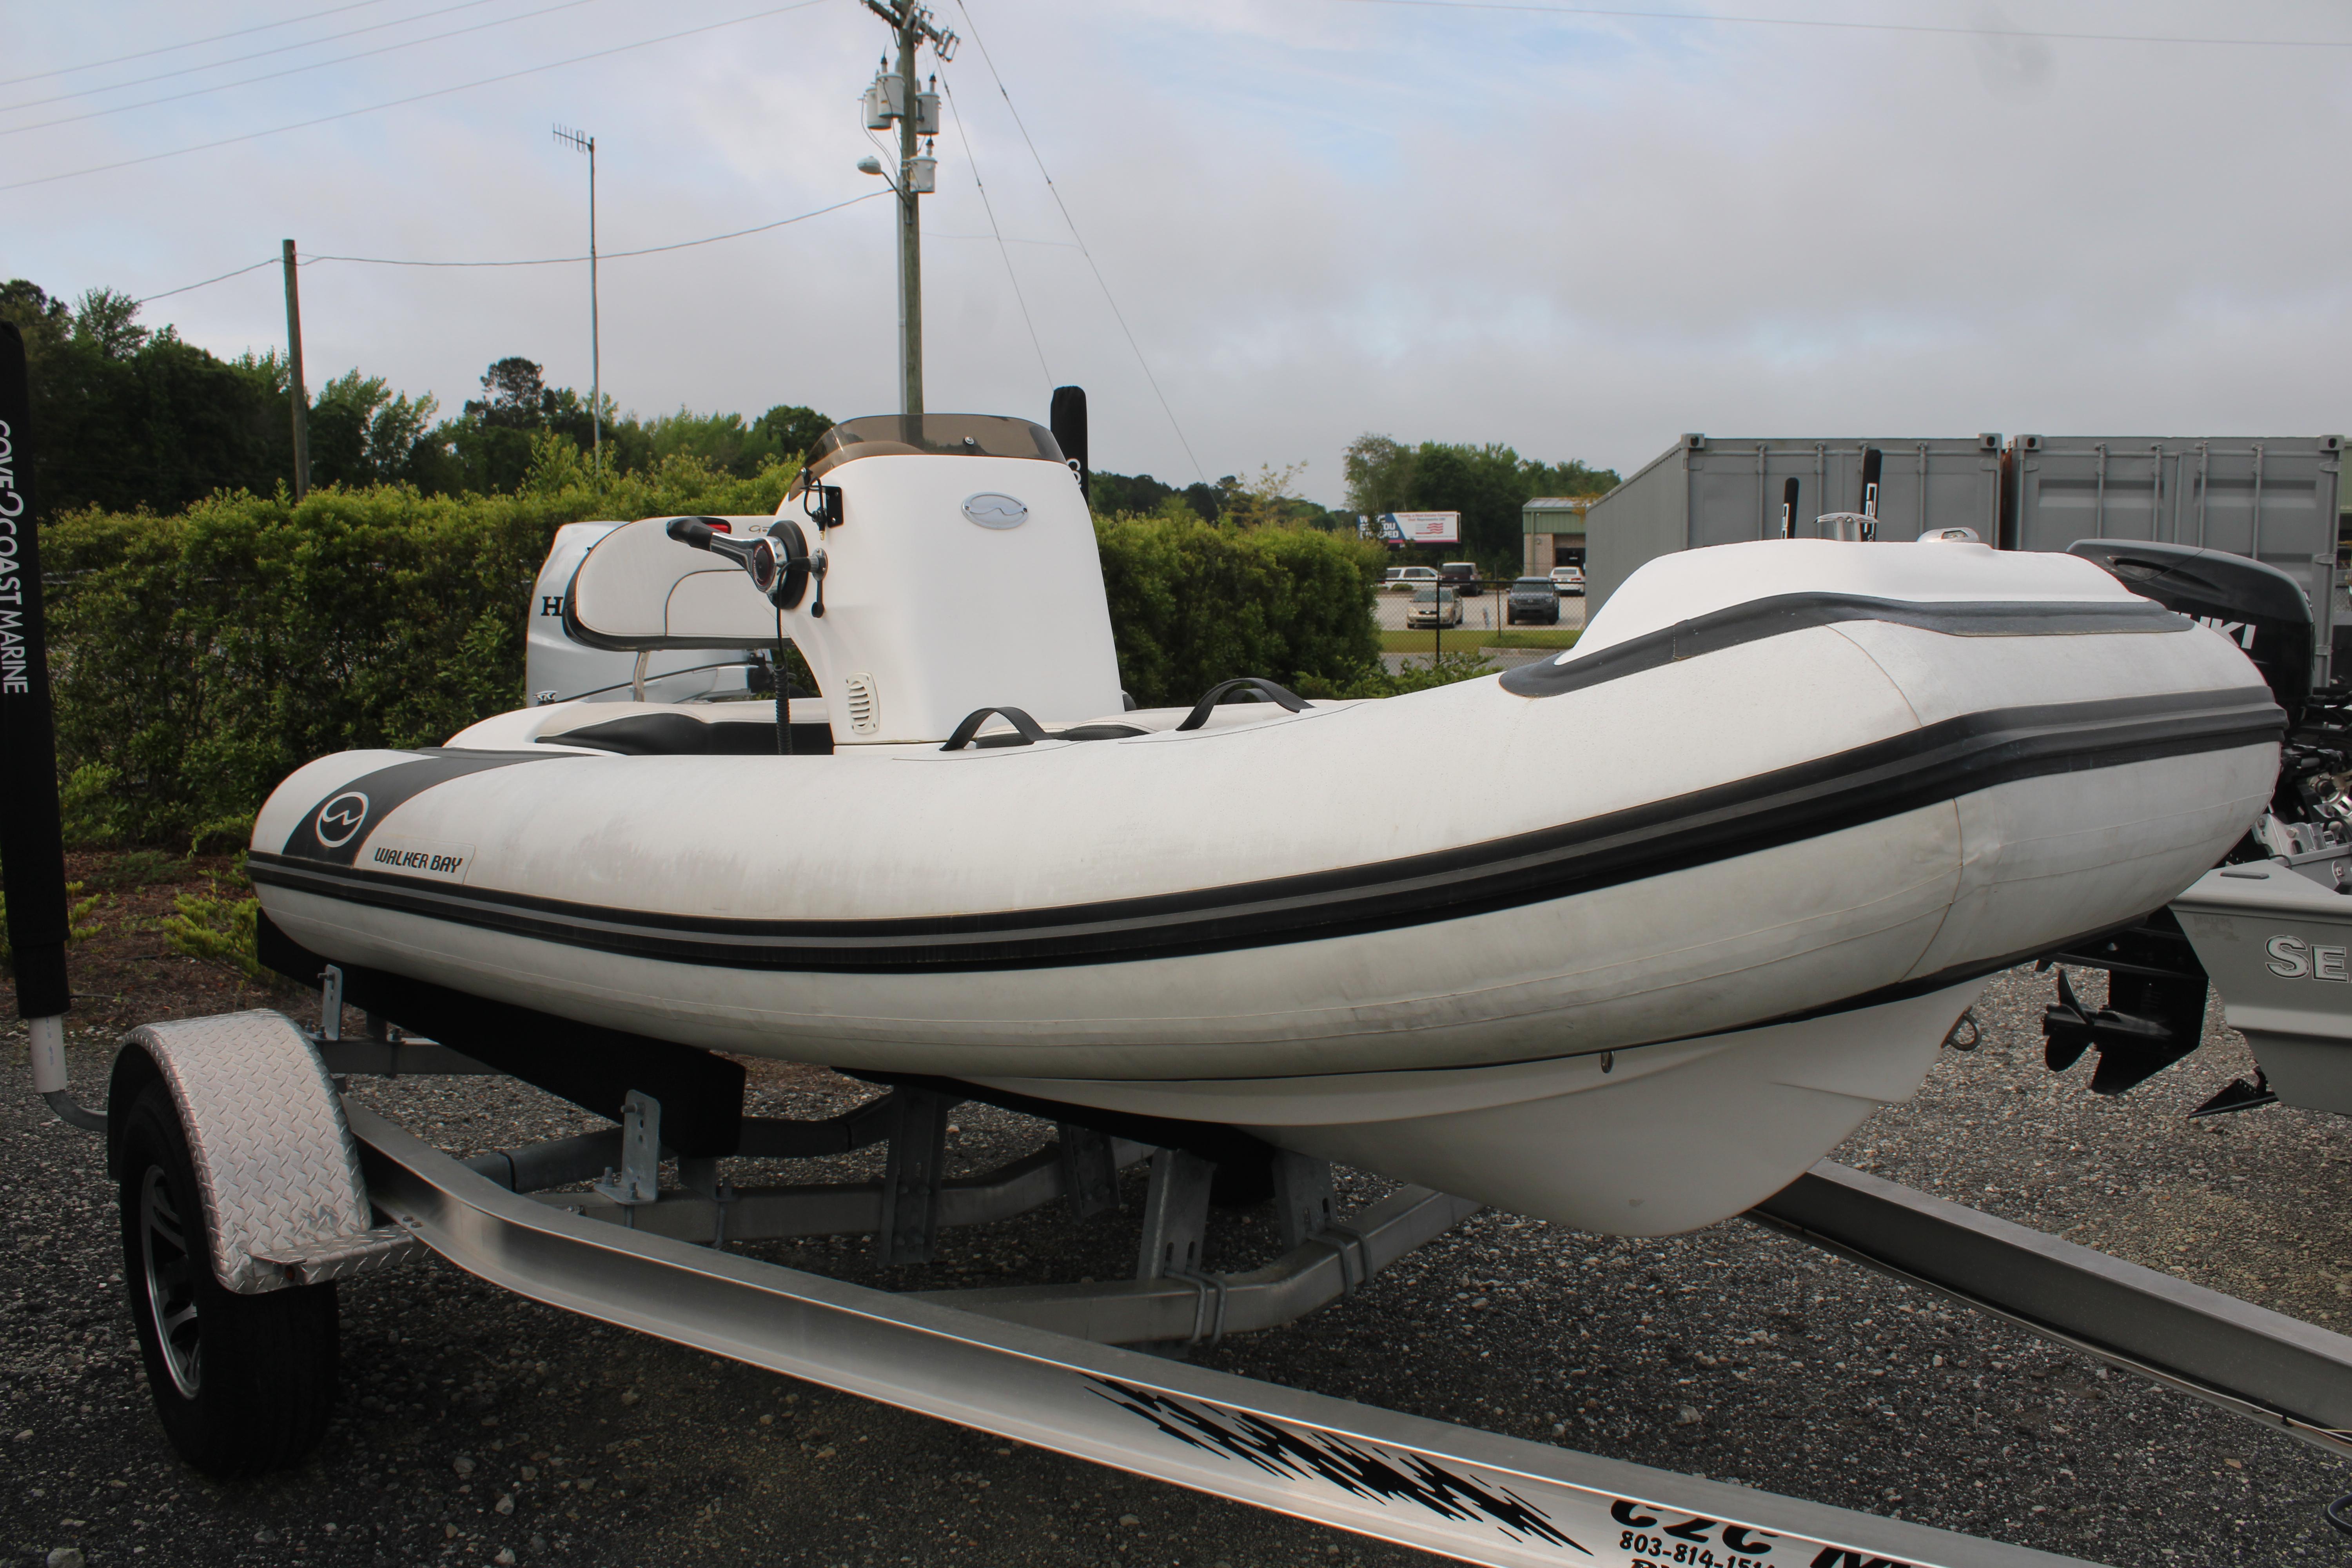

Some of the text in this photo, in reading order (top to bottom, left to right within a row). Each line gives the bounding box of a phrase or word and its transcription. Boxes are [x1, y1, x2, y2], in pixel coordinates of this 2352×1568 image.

[0, 610, 29, 693] MARINE
[375, 847, 463, 873] WALKER BAY
[2265, 935, 2352, 983] SE
[1619, 1530, 1776, 1568] 803-814-15
